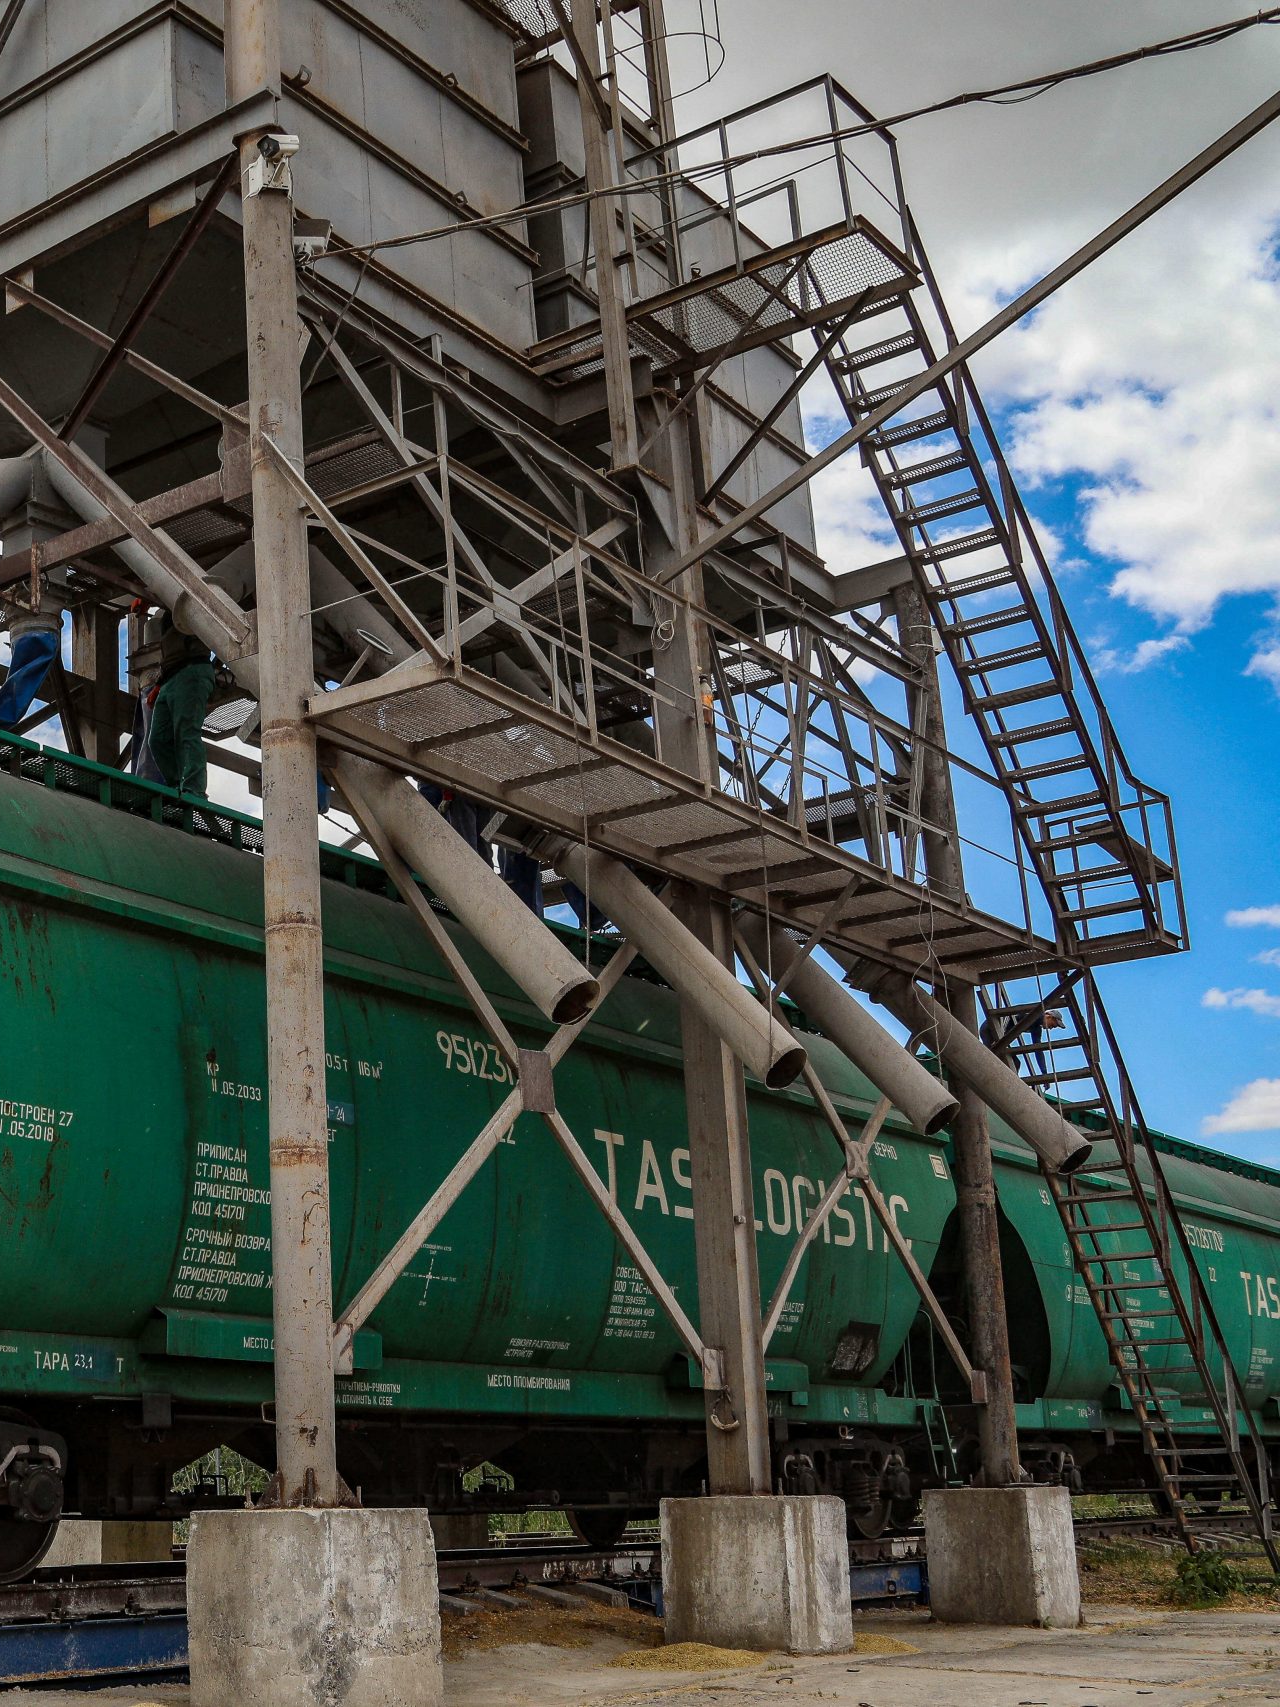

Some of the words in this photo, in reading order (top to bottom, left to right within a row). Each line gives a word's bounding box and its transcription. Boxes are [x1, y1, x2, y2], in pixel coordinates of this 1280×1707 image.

[58, 1110, 74, 1127] 27
[197, 1142, 247, 1164] ПРИПИСАН
[195, 1161, 249, 1183] СТ.ПРАВДА
[594, 1128, 695, 1220] TAS
[191, 1200, 211, 1217] КОД
[214, 1203, 246, 1221] 451701
[186, 1227, 233, 1247] СРОЧНЫЙ
[182, 1246, 237, 1267] СТ.ПРАВДА
[177, 1265, 265, 1289] ПРИДНЕПРОВСКОЙ
[172, 1284, 194, 1299] КОД
[196, 1286, 229, 1303] 451701
[243, 1336, 268, 1350] МЕСТО
[34, 1350, 70, 1371] ТАРА
[487, 1374, 512, 1388] МЕСТО
[513, 1375, 571, 1391] ПЛОМБИРОВАНИЯ
[378, 1395, 394, 1406] СЕБЕ
